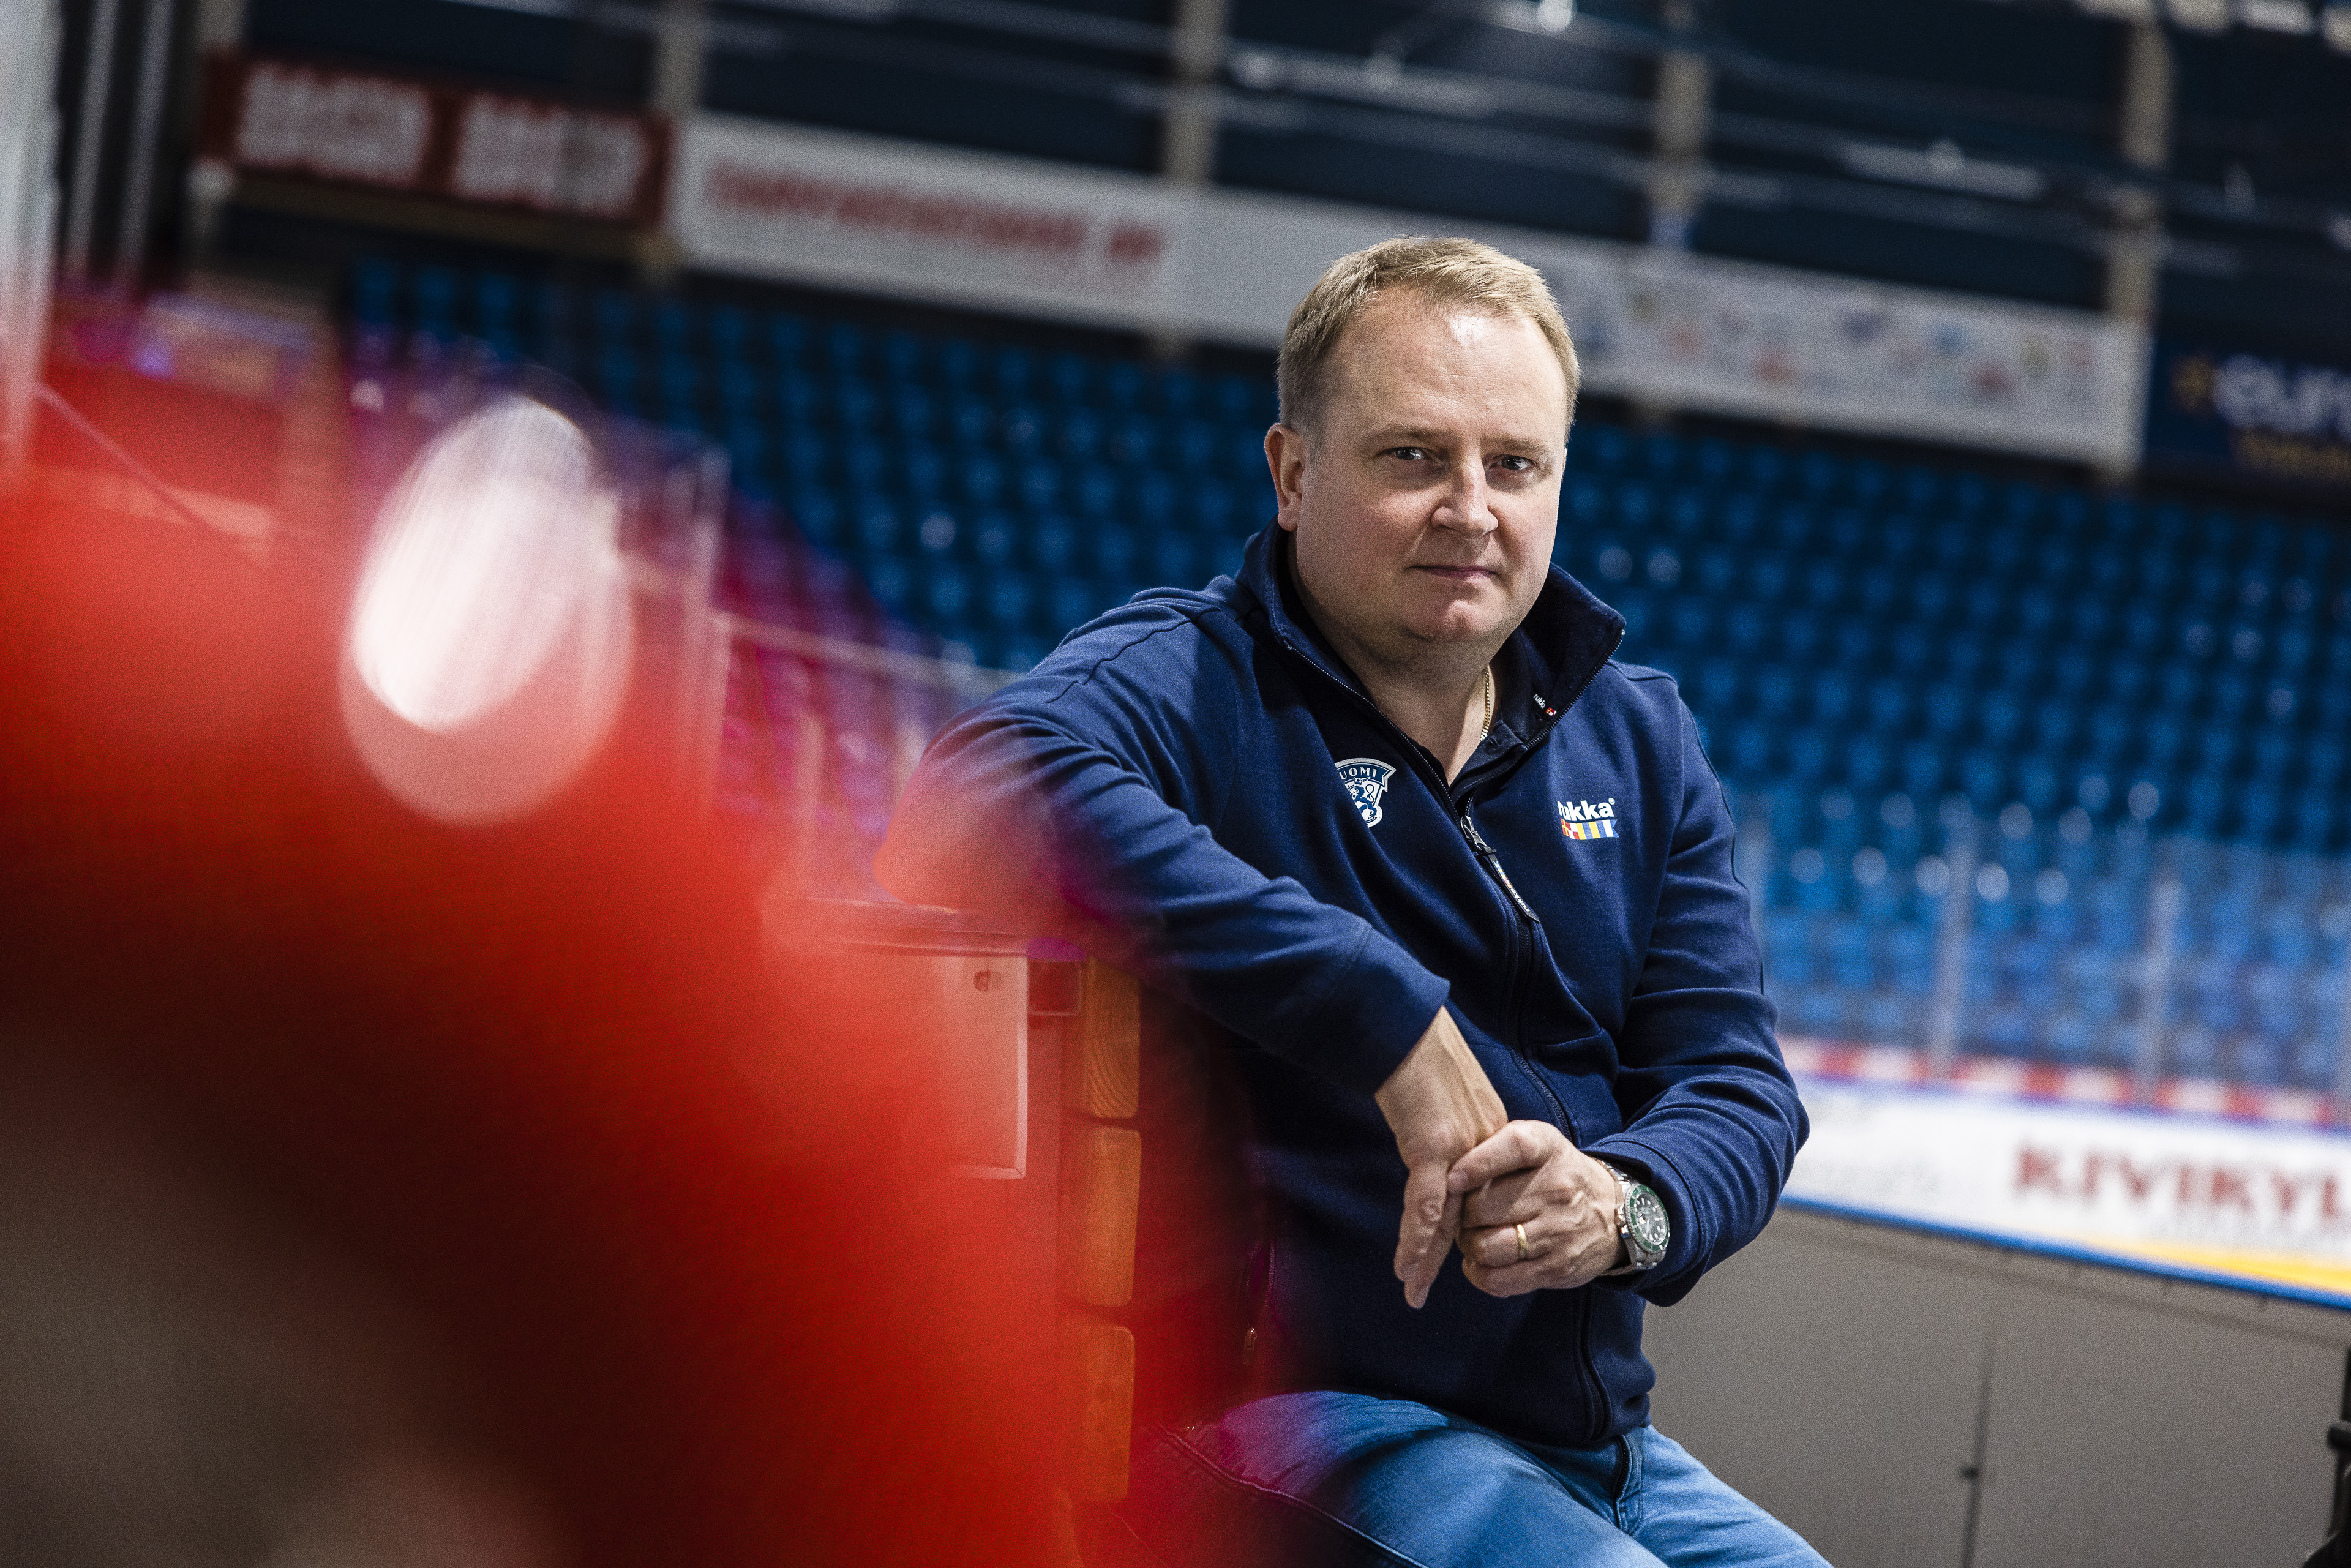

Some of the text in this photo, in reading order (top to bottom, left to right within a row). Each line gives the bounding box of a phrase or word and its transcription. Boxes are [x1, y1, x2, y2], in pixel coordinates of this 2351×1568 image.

[1533, 694, 1546, 709] rukka
[1338, 767, 1377, 780] UOMI
[1510, 888, 1530, 912] rukka
